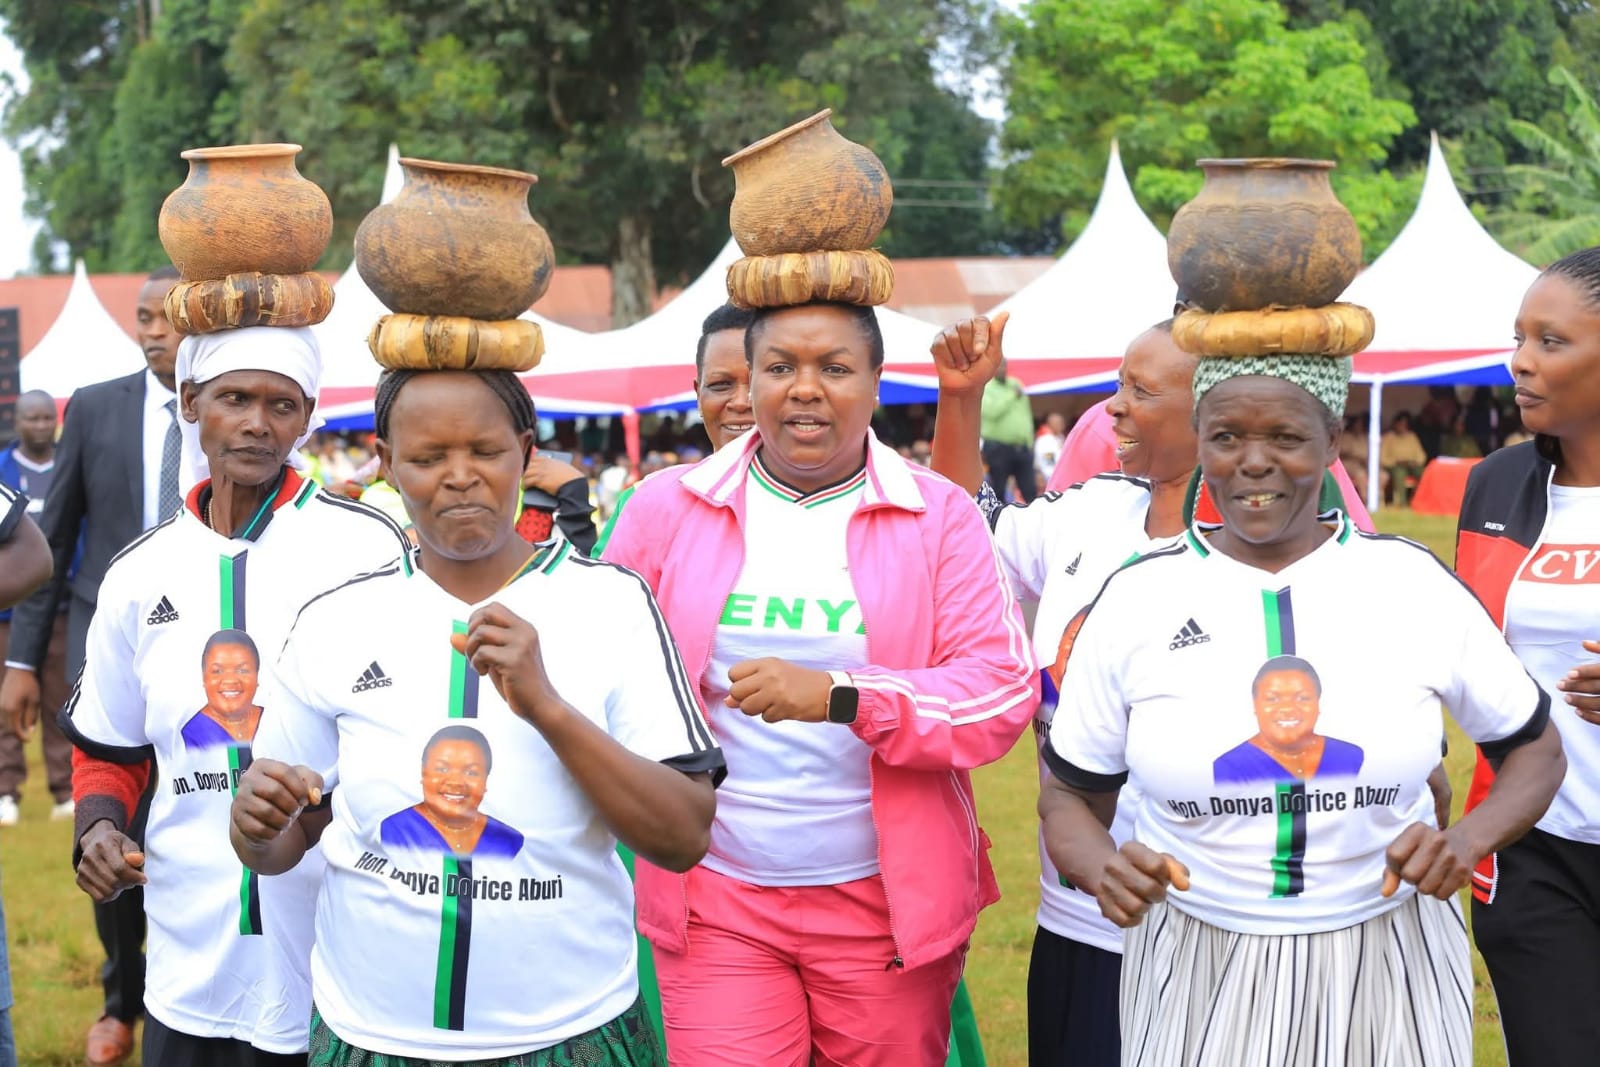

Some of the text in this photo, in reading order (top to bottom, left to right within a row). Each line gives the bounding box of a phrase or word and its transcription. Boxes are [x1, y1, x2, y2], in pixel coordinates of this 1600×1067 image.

[147, 611, 179, 625] adidas
[718, 593, 866, 635] ENY
[1169, 634, 1211, 651] adidas
[352, 678, 392, 693] adidas
[173, 777, 195, 795] on.
[194, 771, 229, 792] Donya
[1167, 784, 1401, 819] Hon. Donya Dorice Aburi
[354, 851, 385, 876] Hon.
[446, 873, 513, 901] Dorice
[518, 874, 563, 901] Aburi
